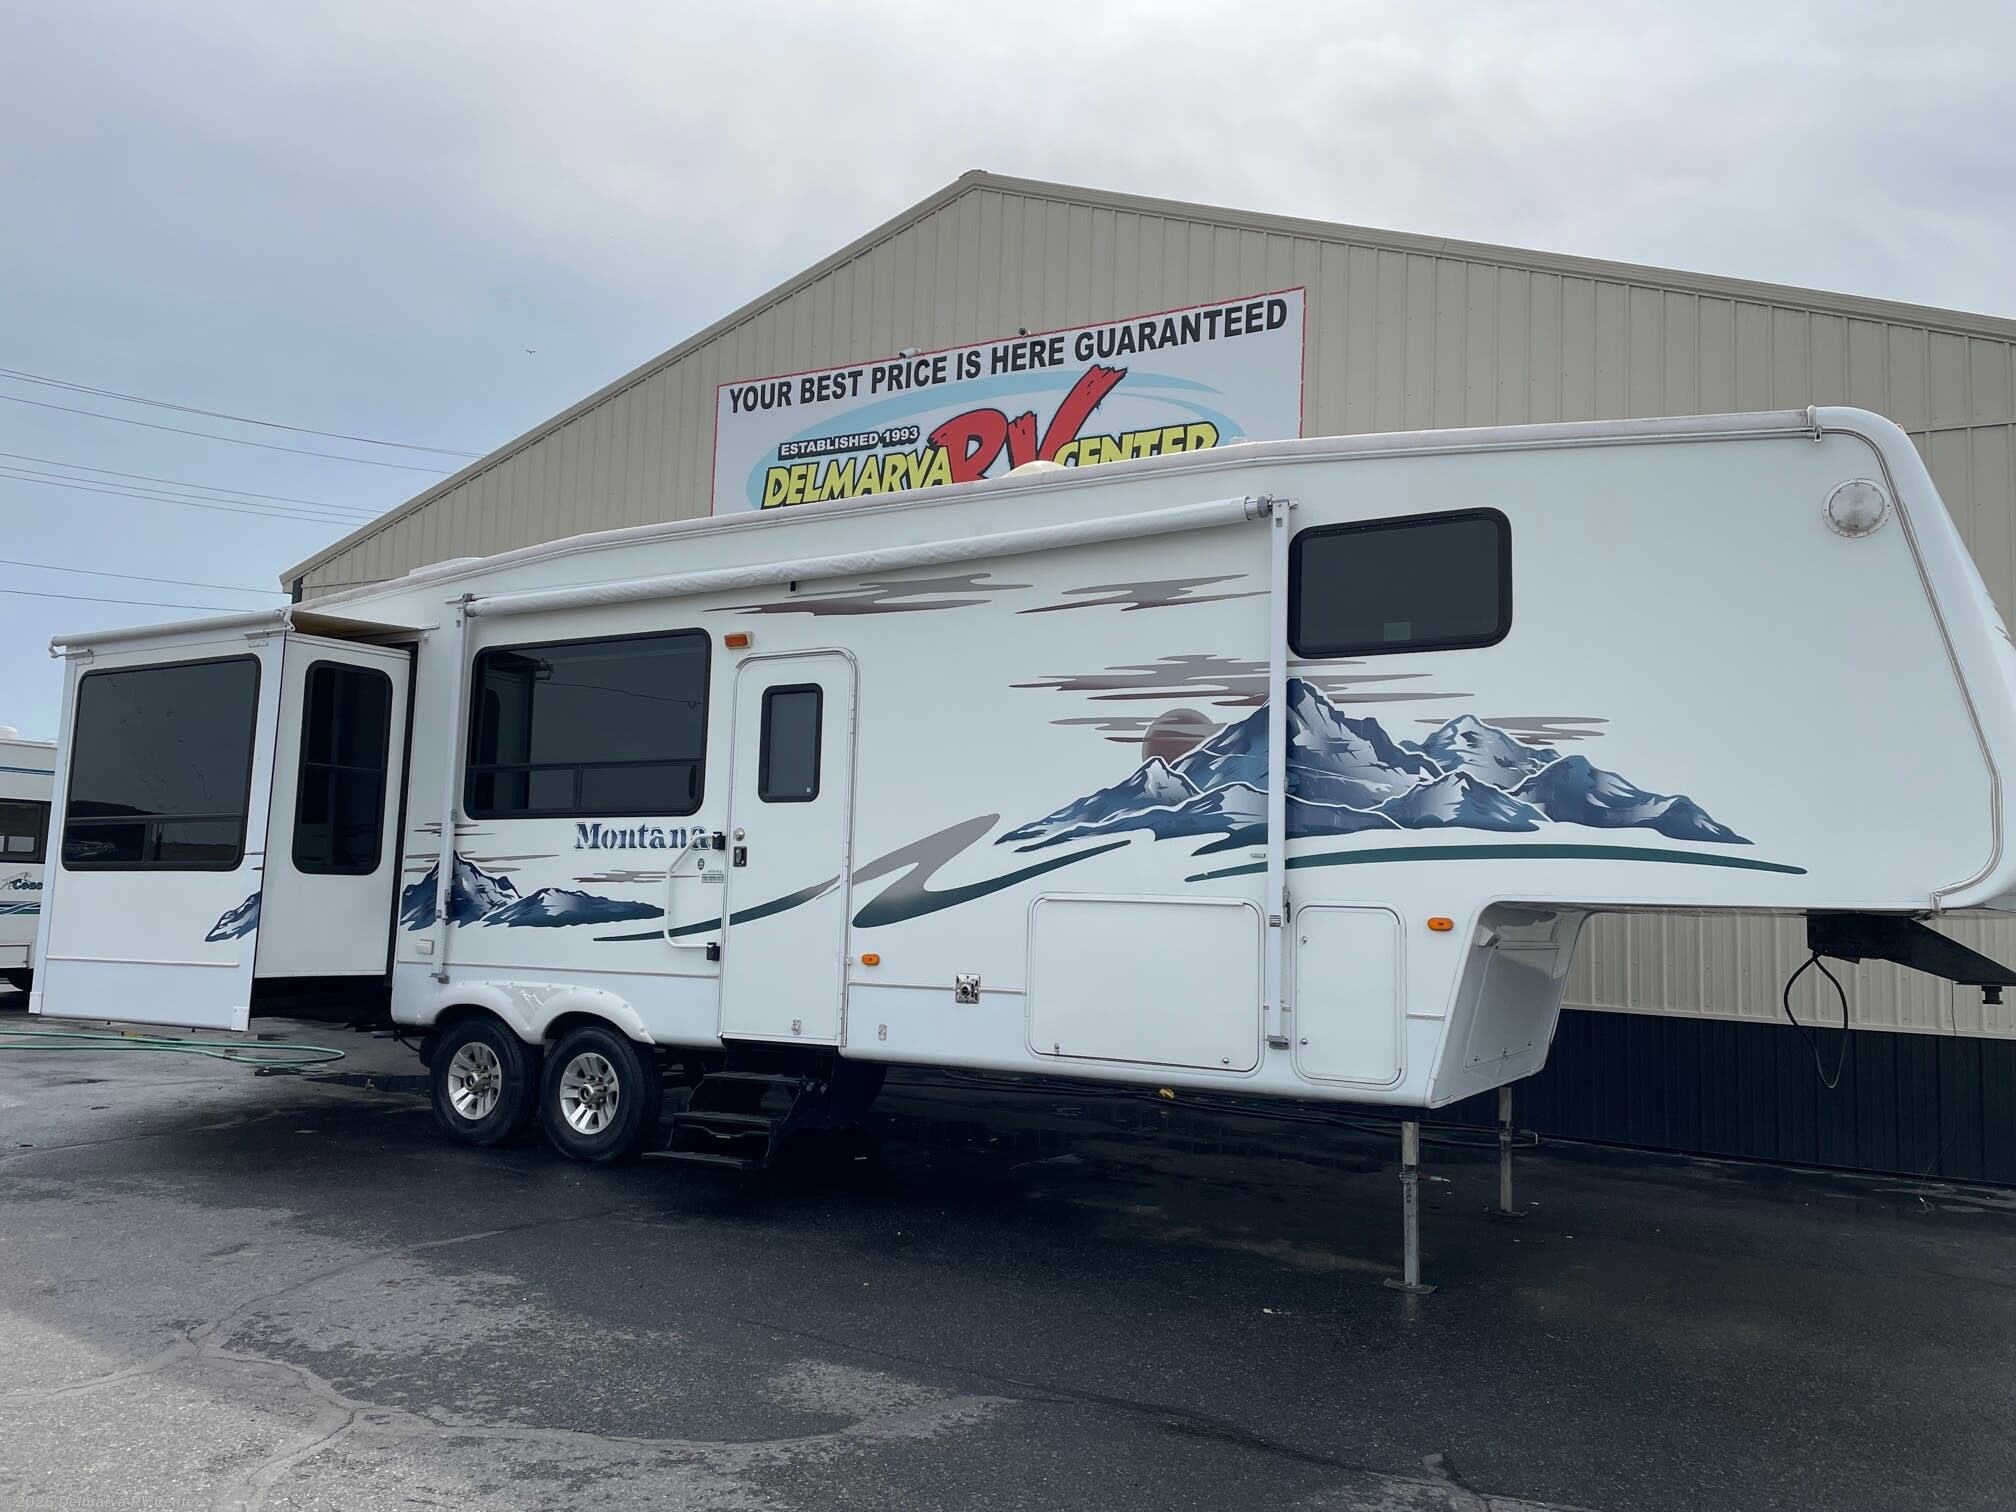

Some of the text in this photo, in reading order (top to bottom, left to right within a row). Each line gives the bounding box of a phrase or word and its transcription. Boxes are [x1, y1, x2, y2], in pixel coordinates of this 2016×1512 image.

[730, 298, 1288, 413] YOUR BEST PRICE IS HERE GUARANTEED
[761, 364, 1220, 510] DELMARVA RV CENTER
[779, 426, 920, 459] ESTABLISHED 1993
[574, 821, 711, 851] Montana
